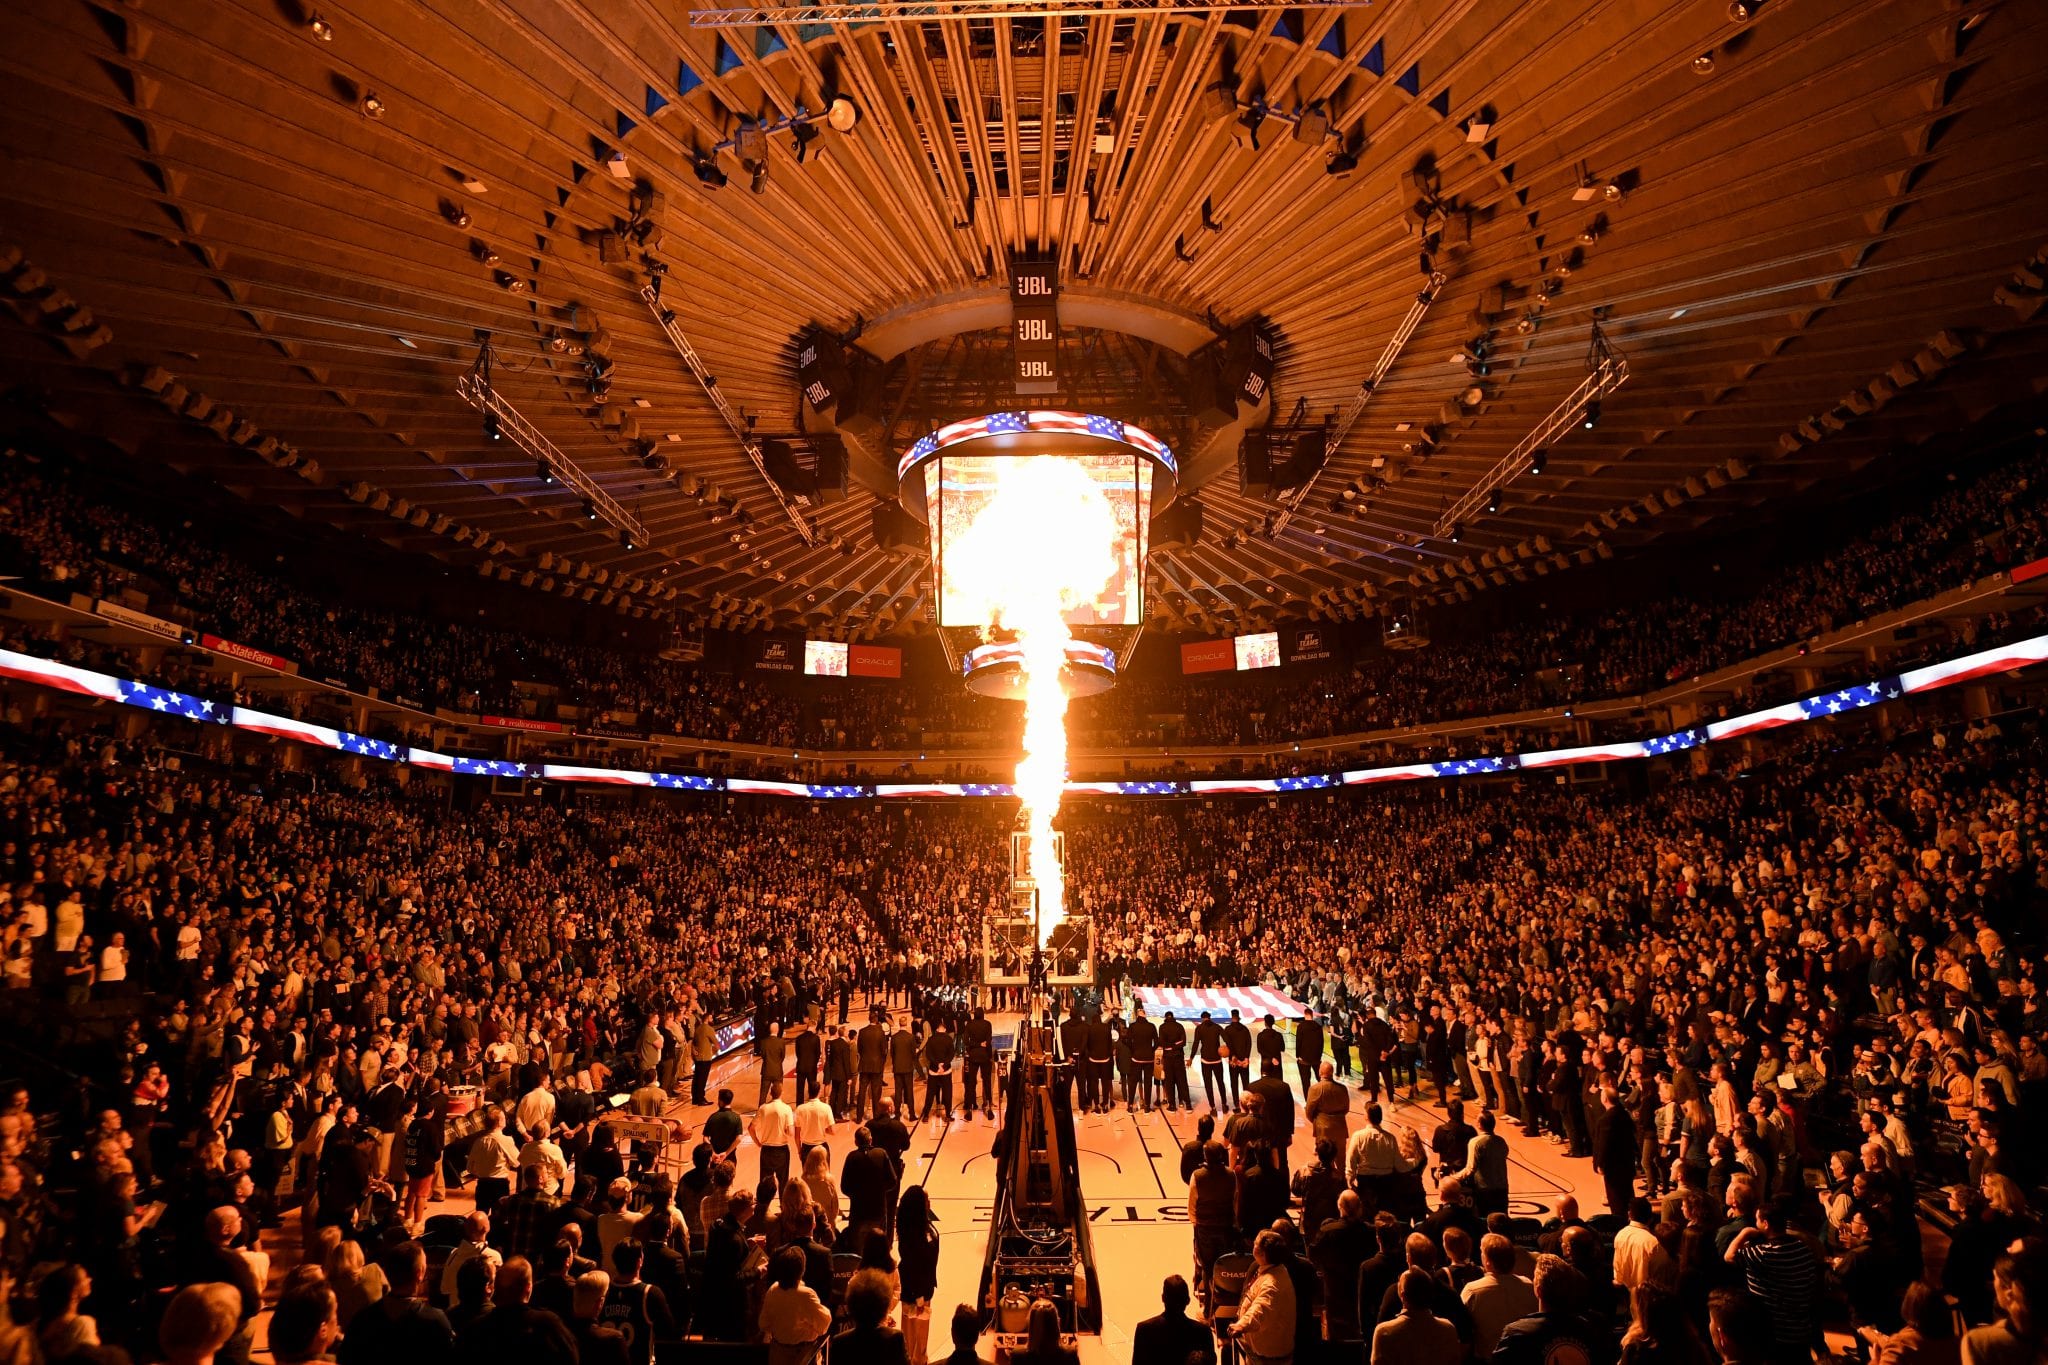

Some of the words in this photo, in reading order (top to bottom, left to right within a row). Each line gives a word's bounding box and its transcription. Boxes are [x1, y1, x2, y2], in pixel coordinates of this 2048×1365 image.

[1018, 276, 1052, 296] JBL
[1018, 319, 1053, 341] JBL
[1255, 334, 1273, 361] JBL
[801, 345, 817, 369] JBL
[1020, 361, 1053, 377] JBL
[806, 380, 831, 404] JBL
[1245, 371, 1265, 399] JBL
[855, 657, 896, 666] ORACLE
[1187, 652, 1226, 662] ORACLE
[1290, 653, 1317, 662] DOWNLOAD
[1318, 651, 1330, 659] NOW
[755, 662, 781, 670] DOWNLOAD
[623, 1129, 649, 1139] SPALDING
[1457, 1194, 1474, 1209] 30
[604, 1304, 632, 1319] CURRY
